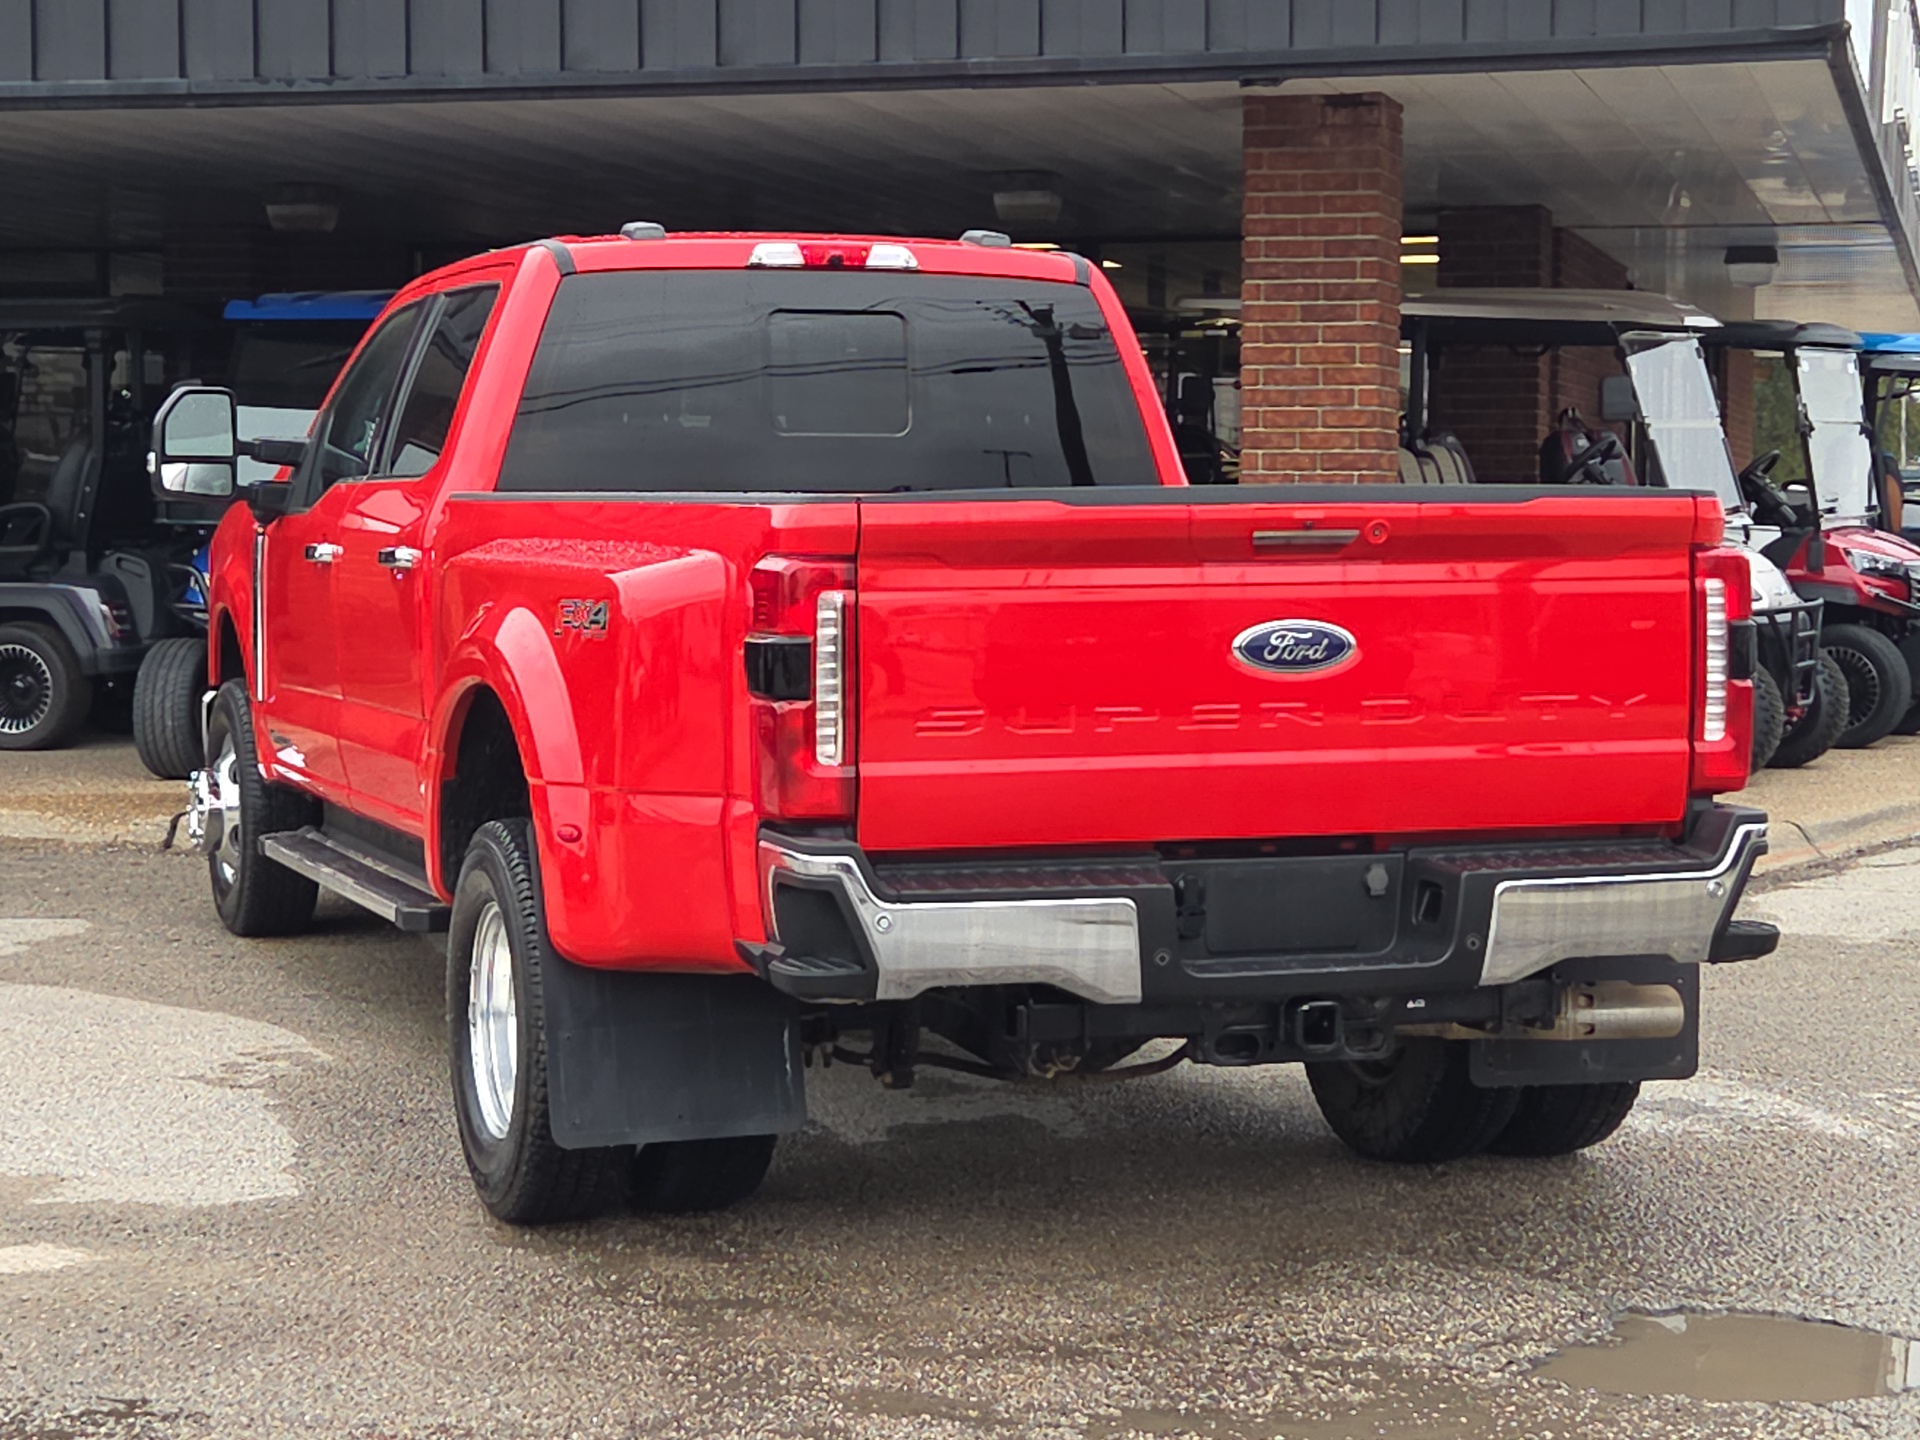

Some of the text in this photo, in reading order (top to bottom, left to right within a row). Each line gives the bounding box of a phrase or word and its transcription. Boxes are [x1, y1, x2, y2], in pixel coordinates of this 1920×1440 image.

[555, 599, 608, 635] FX4
[1263, 630, 1329, 660] Ford
[914, 692, 1648, 737] SUPER DUTY
